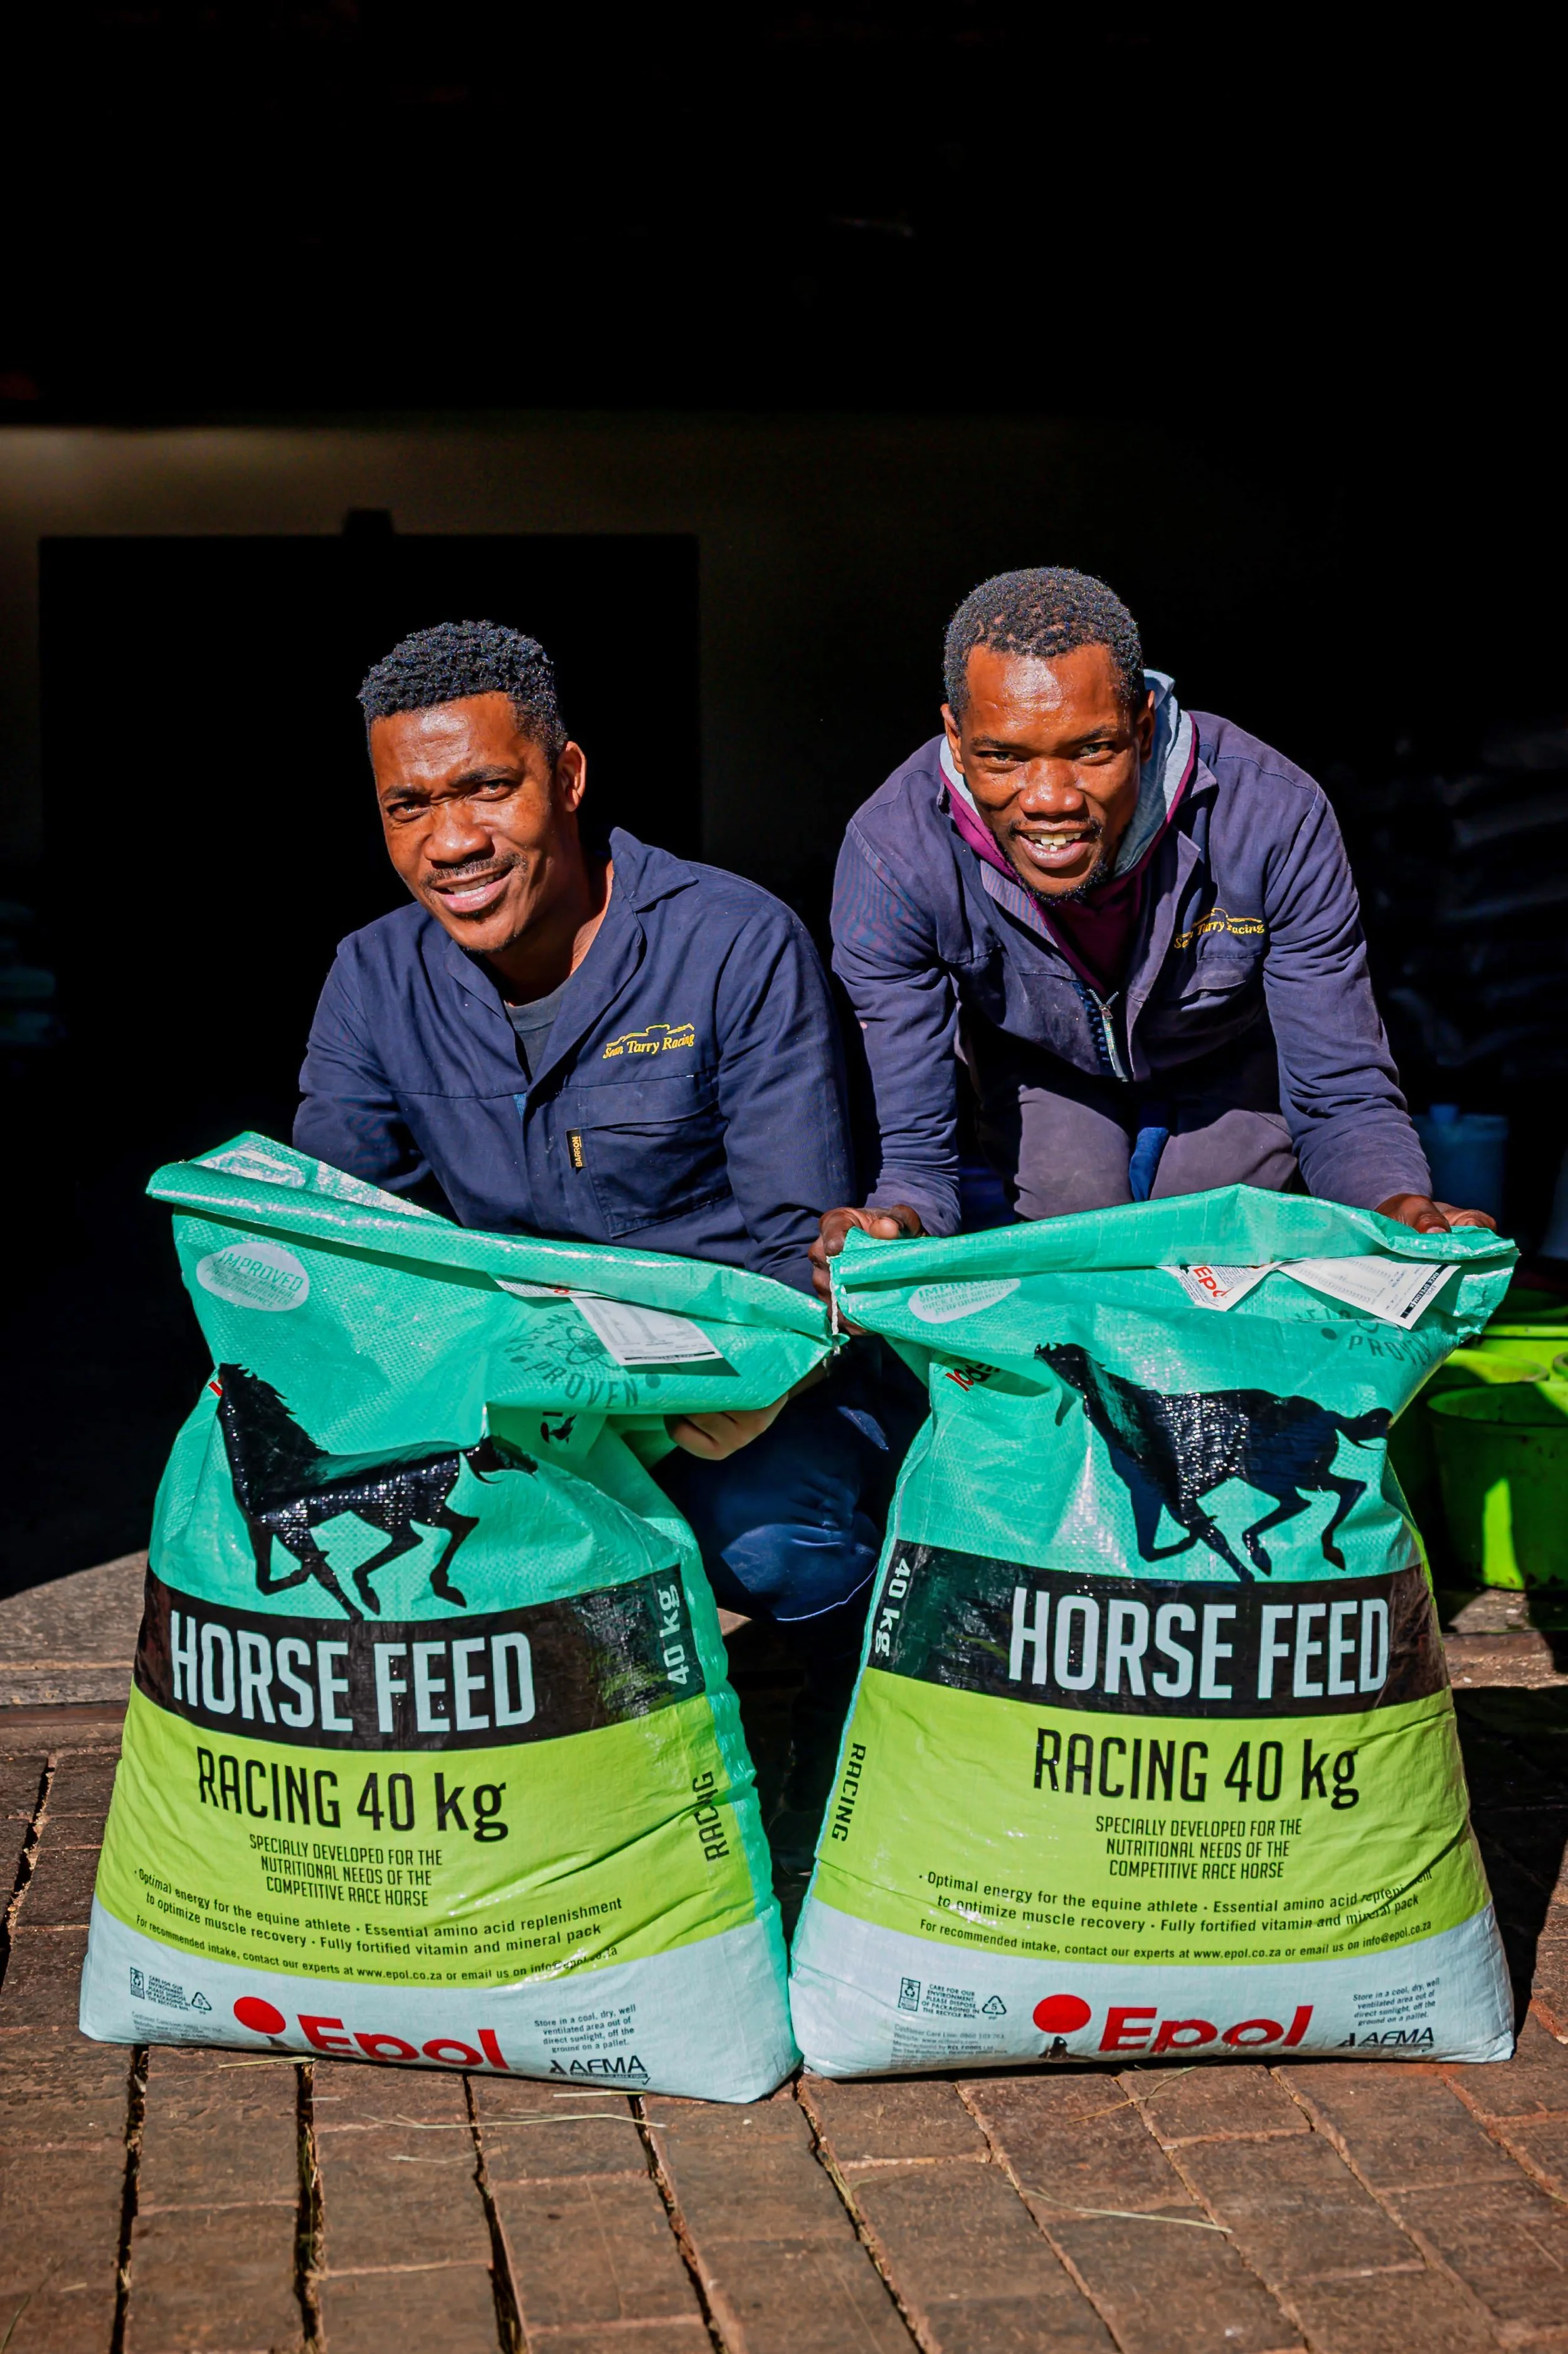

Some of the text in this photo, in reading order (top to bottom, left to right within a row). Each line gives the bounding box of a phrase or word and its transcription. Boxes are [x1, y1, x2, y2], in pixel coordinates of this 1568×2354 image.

[1197, 921, 1224, 936] Tarry
[603, 1034, 695, 1059] Sean Tarry Racing
[572, 1136, 583, 1167] BARRON
[218, 1251, 304, 1292] IMPROVED
[523, 1360, 638, 1409] PROVEN
[875, 1557, 910, 1657] 40 kg
[658, 1584, 689, 1685] 40 kg
[1009, 1587, 1389, 1699] HORSE FEED
[170, 1610, 536, 1732] HORSE FEED
[1034, 1728, 1359, 1810] RACING 40 kg
[196, 1746, 508, 1842] RACING 40 kg
[832, 1742, 866, 1842] RACING
[692, 1771, 730, 1862] RACNG
[1096, 1816, 1302, 1837] SPECIALLY DEVELOPED FOR THE
[250, 1834, 442, 1865] SPECIALLY DEVELOPED FOR THE
[1106, 1838, 1290, 1858] NUTRITIONAL NEEDS OF THE
[261, 1855, 432, 1885] NUTRITIONAL NEEDS OF THE
[928, 1868, 1432, 1913] Optimal energy for the equine athlete Essential amino acid replenient
[1110, 1860, 1284, 1880] COMPETITIVE RACE HORSE
[139, 1869, 622, 1938] Optimal energy for the equine athlete Essential amino acid replenishment
[267, 1876, 429, 1907] COMPETITIVE RACE HORSE
[146, 1892, 601, 1955] to optimize muscle recovery Fully fortified vitamin and mineral pack
[938, 1895, 950, 1907] to
[956, 1900, 1016, 1918] optimize
[1022, 1911, 1075, 1926] muscle
[1081, 1917, 1145, 1933] recovery
[1161, 1919, 1195, 1934] Fully
[1200, 1919, 1255, 1932] fortified
[1262, 1918, 1312, 1930] vitamin
[1317, 1914, 1340, 1927] and
[1394, 1894, 1419, 1914] pack
[137, 1914, 526, 1981] For recommended intake, contact our experts at www.epol.co.za or email us on
[920, 1919, 1431, 1961] For recommended intake, contact our experts at www.epol.co.za or email us on info@epol.co.za
[543, 2025, 584, 2035] ventilated
[623, 2016, 631, 2024] of
[618, 2004, 636, 2015] well
[1098, 2005, 1313, 2054] Epol
[297, 2014, 511, 2070] Epol
[552, 2044, 580, 2054] ground
[608, 2029, 618, 2037] off
[1360, 2027, 1434, 2044] AFMA
[569, 2055, 647, 2073] AFMA
